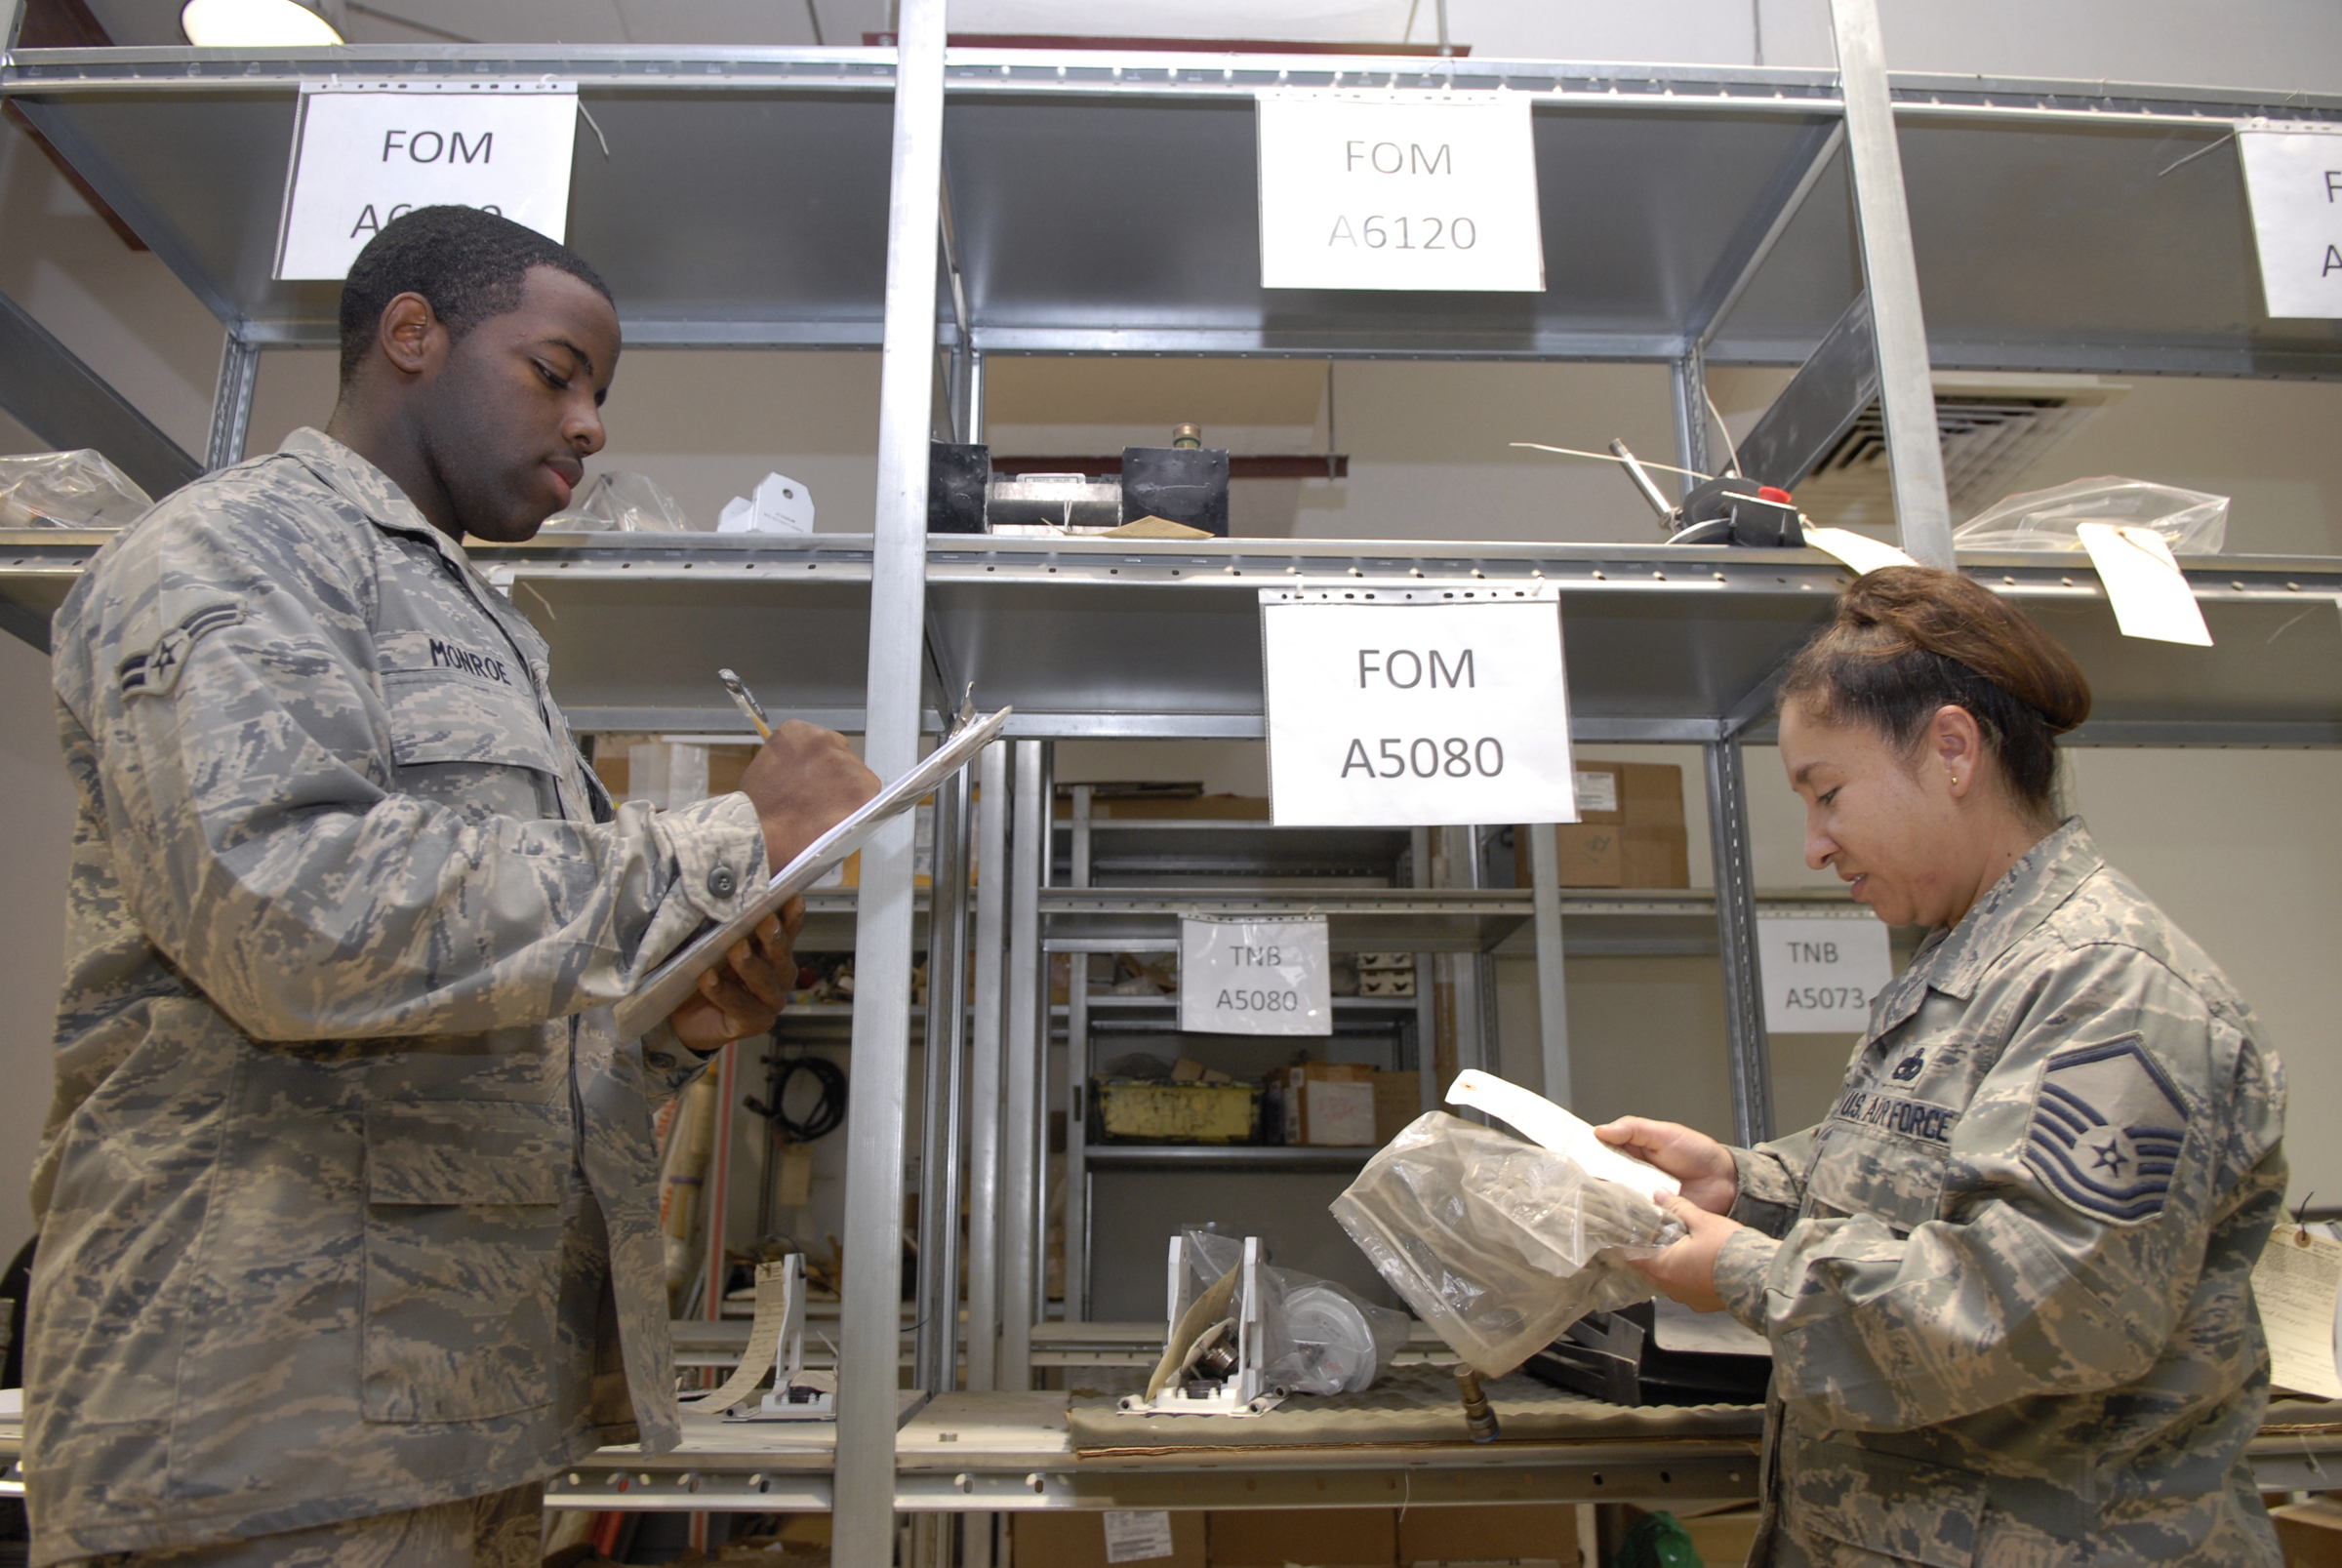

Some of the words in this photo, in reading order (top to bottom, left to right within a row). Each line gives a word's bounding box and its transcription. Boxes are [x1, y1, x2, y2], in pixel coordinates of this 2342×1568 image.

[382, 129, 494, 164] FOM
[1346, 140, 1452, 176] FOM
[1327, 214, 1476, 250] A6120
[428, 637, 512, 686] MONROE
[1358, 649, 1475, 689] FOM
[1340, 737, 1505, 779] A5080
[1229, 945, 1282, 967] TNB
[1786, 942, 1839, 964] TNB
[1216, 988, 1298, 1012] A5080
[1785, 986, 1867, 1010] A5073
[1861, 1095, 1891, 1127] AIR
[1886, 1100, 1954, 1144] FORCE
